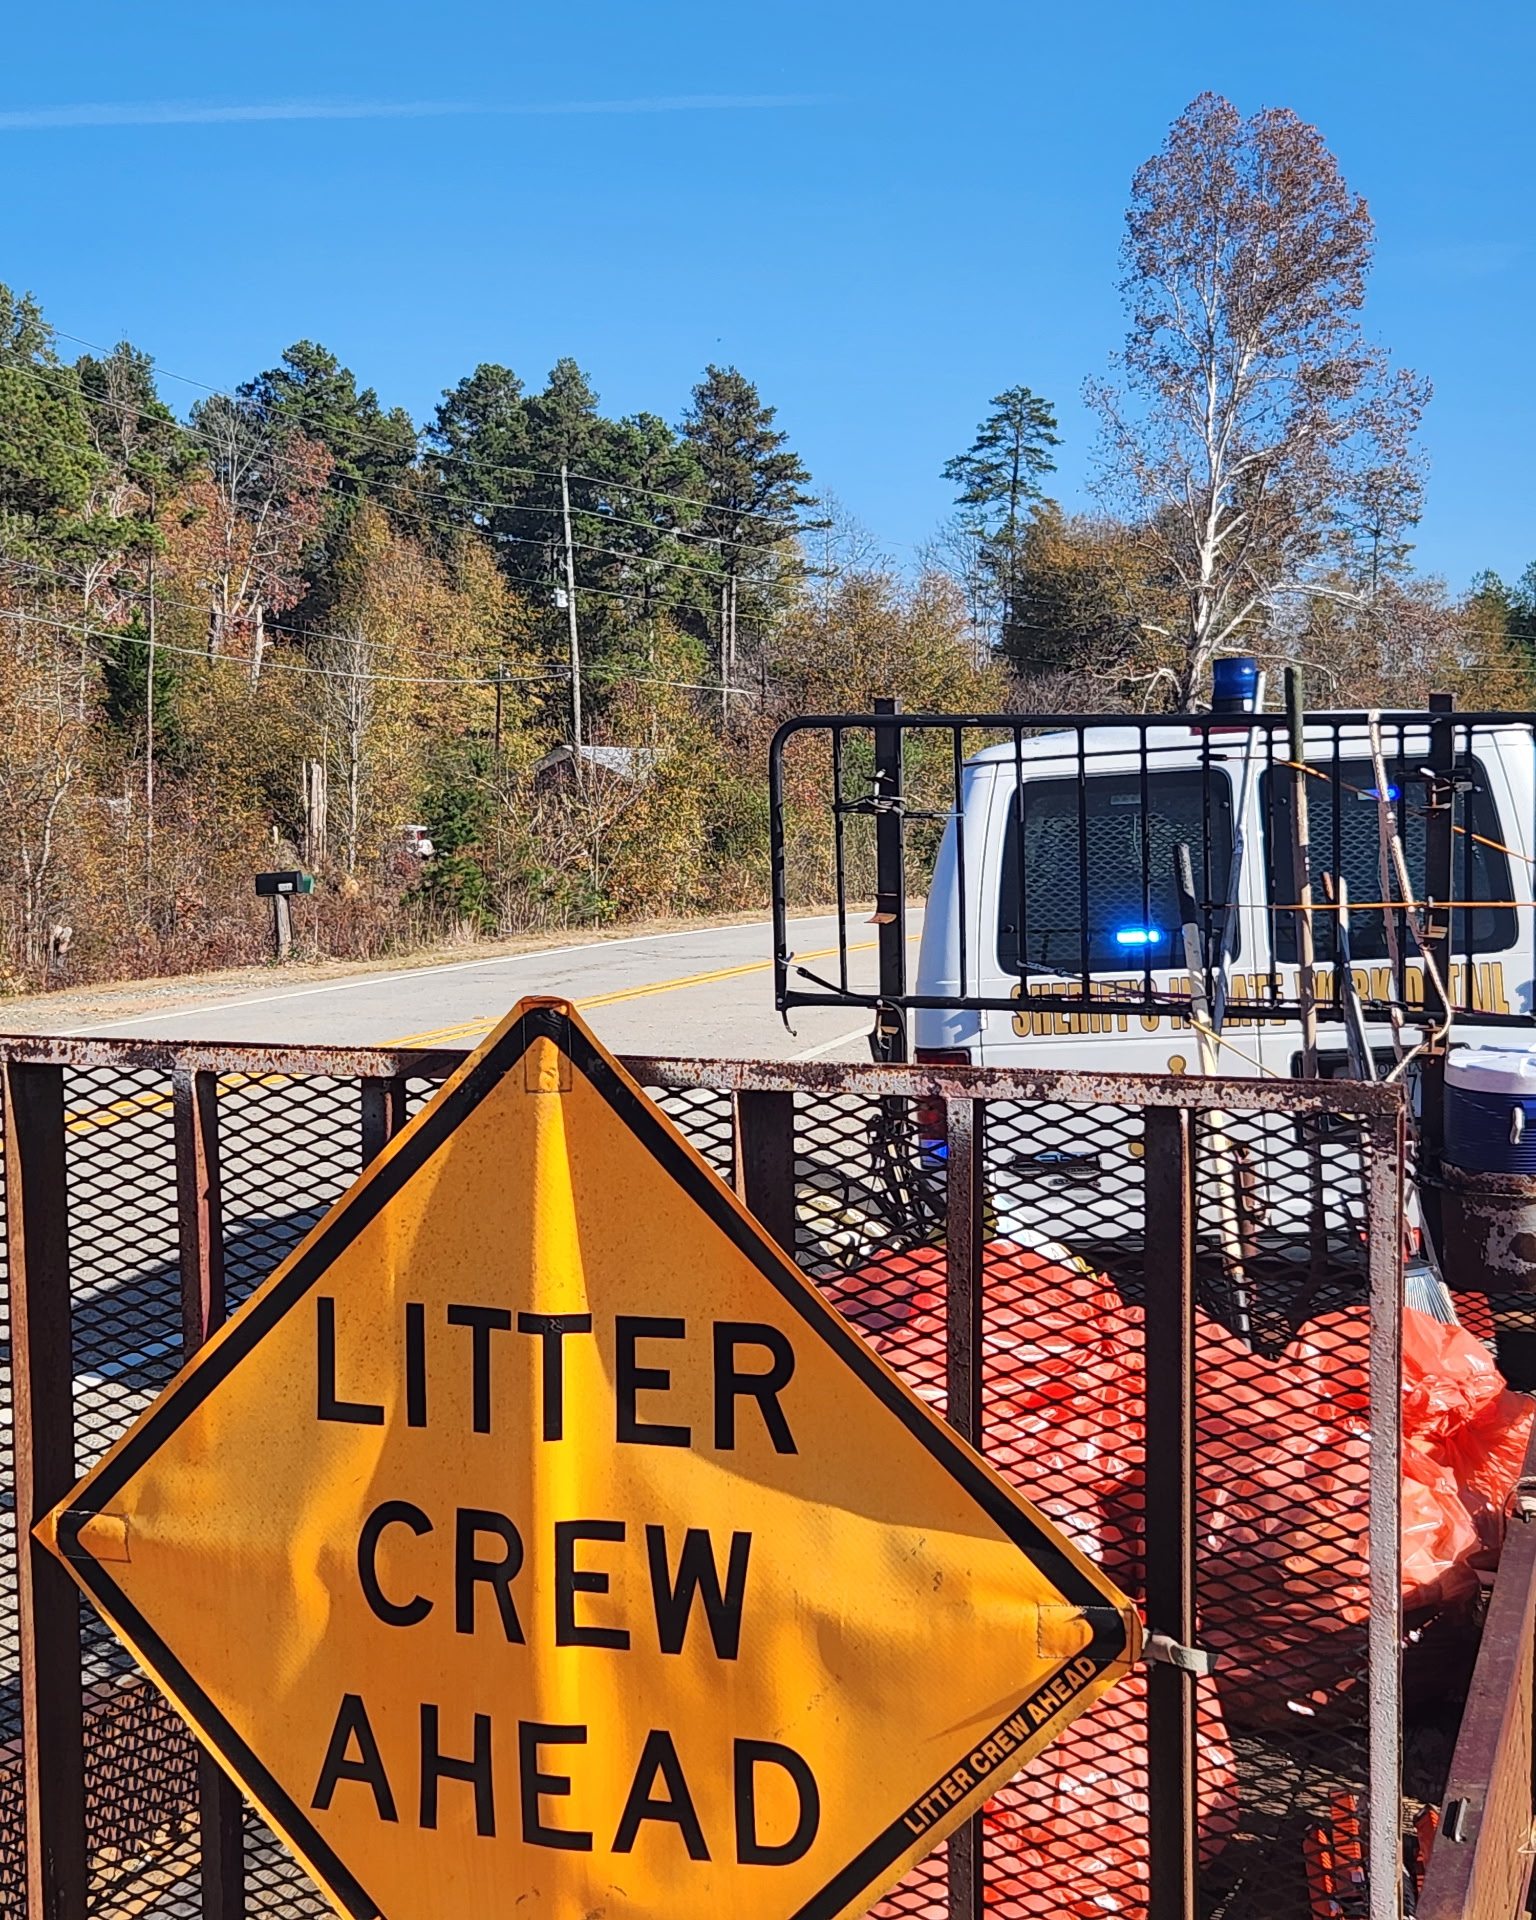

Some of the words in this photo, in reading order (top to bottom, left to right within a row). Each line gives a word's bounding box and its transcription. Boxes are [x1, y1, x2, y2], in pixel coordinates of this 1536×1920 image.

[1404, 962, 1509, 1015] DTAIL
[317, 1296, 798, 1454] LITTER
[357, 1500, 752, 1661] CREW
[310, 1693, 820, 1866] AHEAD
[903, 1768, 975, 1835] LITTER
[969, 1715, 1030, 1775] CREW
[1026, 1656, 1097, 1724] AHEAD
